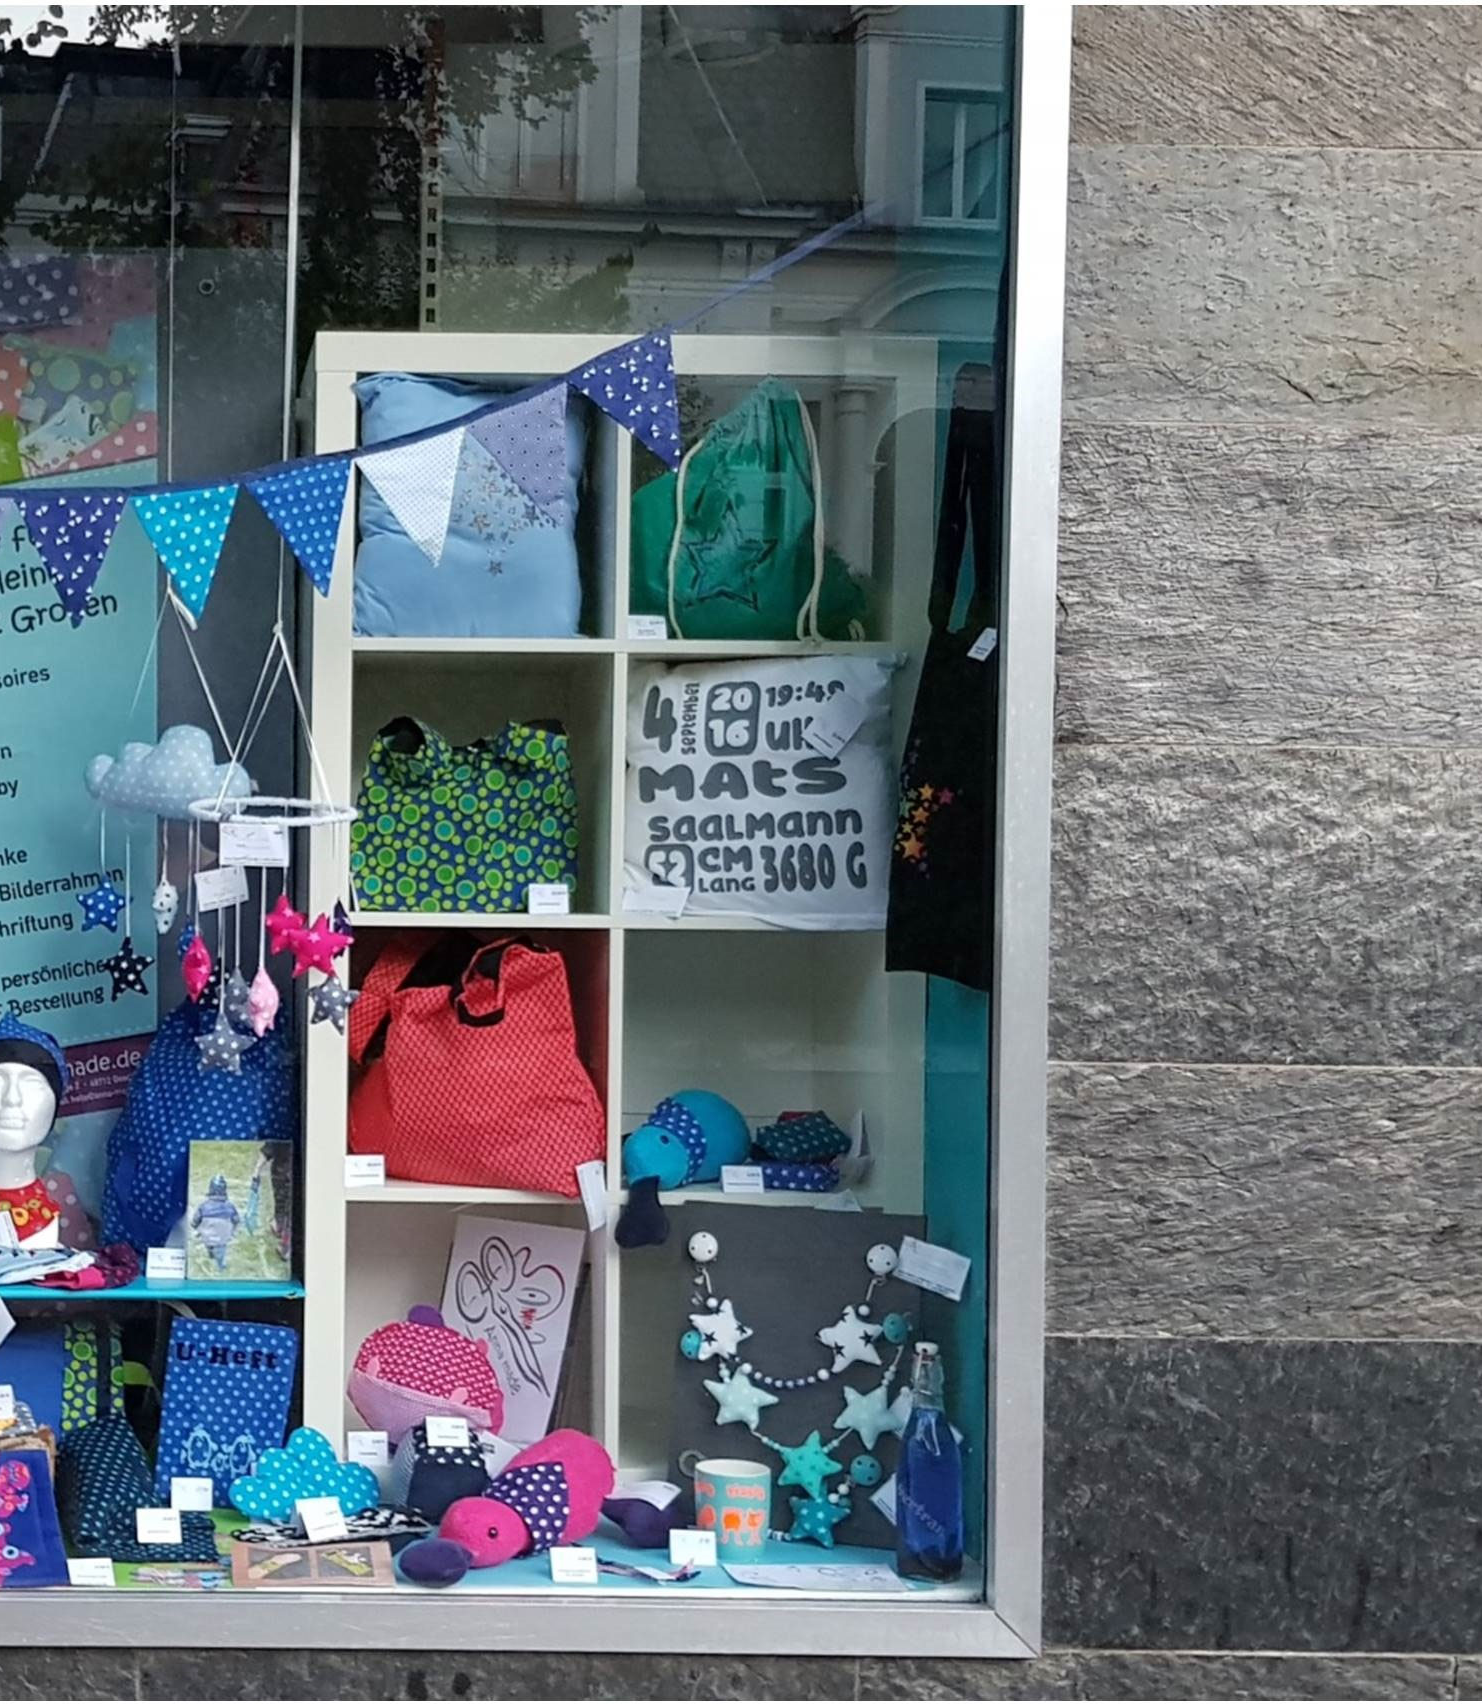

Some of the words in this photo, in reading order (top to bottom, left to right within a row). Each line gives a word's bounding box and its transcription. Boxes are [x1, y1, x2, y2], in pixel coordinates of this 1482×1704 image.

[11, 594, 118, 633] Groen
[711, 687, 753, 711] 20
[643, 685, 678, 753] 4
[708, 719, 750, 747] 16
[760, 843, 835, 893] 3680
[846, 841, 868, 889] G
[2, 959, 108, 992] persönliche
[7, 986, 105, 1018] Bestellung
[176, 1343, 278, 1369] U-Heft
